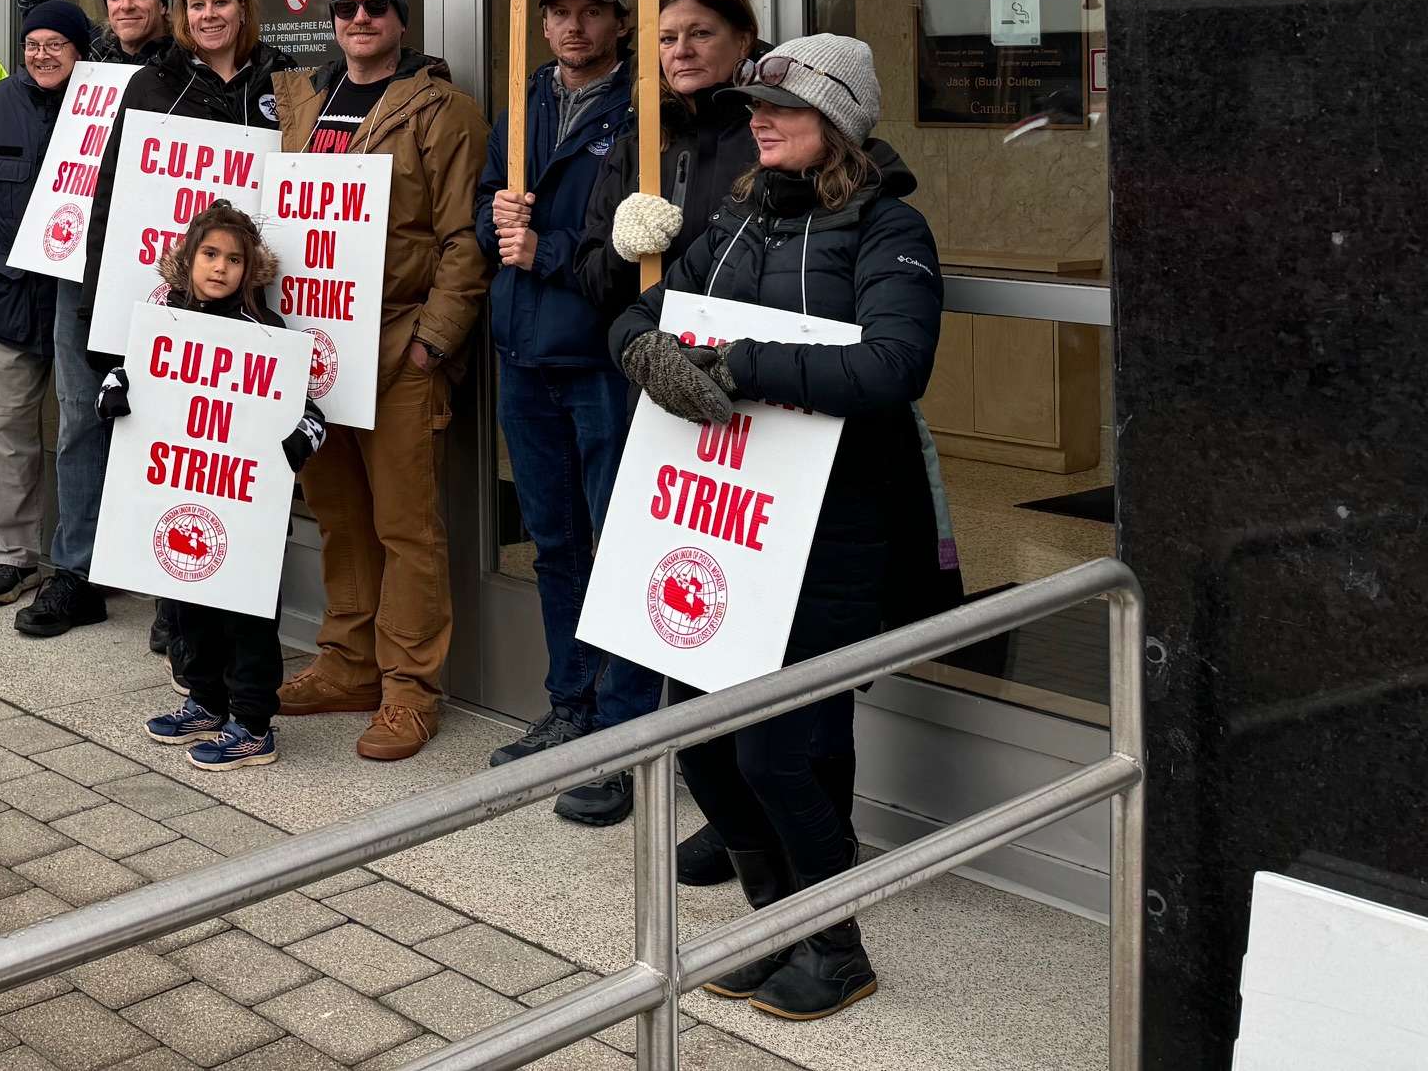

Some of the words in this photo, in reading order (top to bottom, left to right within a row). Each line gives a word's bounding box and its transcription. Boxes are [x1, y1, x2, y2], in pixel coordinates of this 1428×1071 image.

[263, 34, 276, 43] NOT
[277, 32, 312, 42] PERMITTED
[271, 23, 277, 31] A
[277, 21, 318, 32] SMOKE-FREE
[292, 43, 327, 53] ENTRANCE
[946, 77, 971, 87] Jack
[1006, 76, 1042, 87] Cullen
[79, 124, 109, 157] ON
[309, 129, 352, 154] UPW
[140, 137, 260, 190] C.U.P.W.
[277, 180, 370, 222] C.U.P.W.
[304, 229, 336, 269] ON
[280, 275, 356, 321] STRIKE
[149, 335, 283, 400] C.U.P.W.
[186, 395, 234, 443] ON
[146, 441, 258, 503] STRIKE
[650, 464, 775, 552] STRIKE
